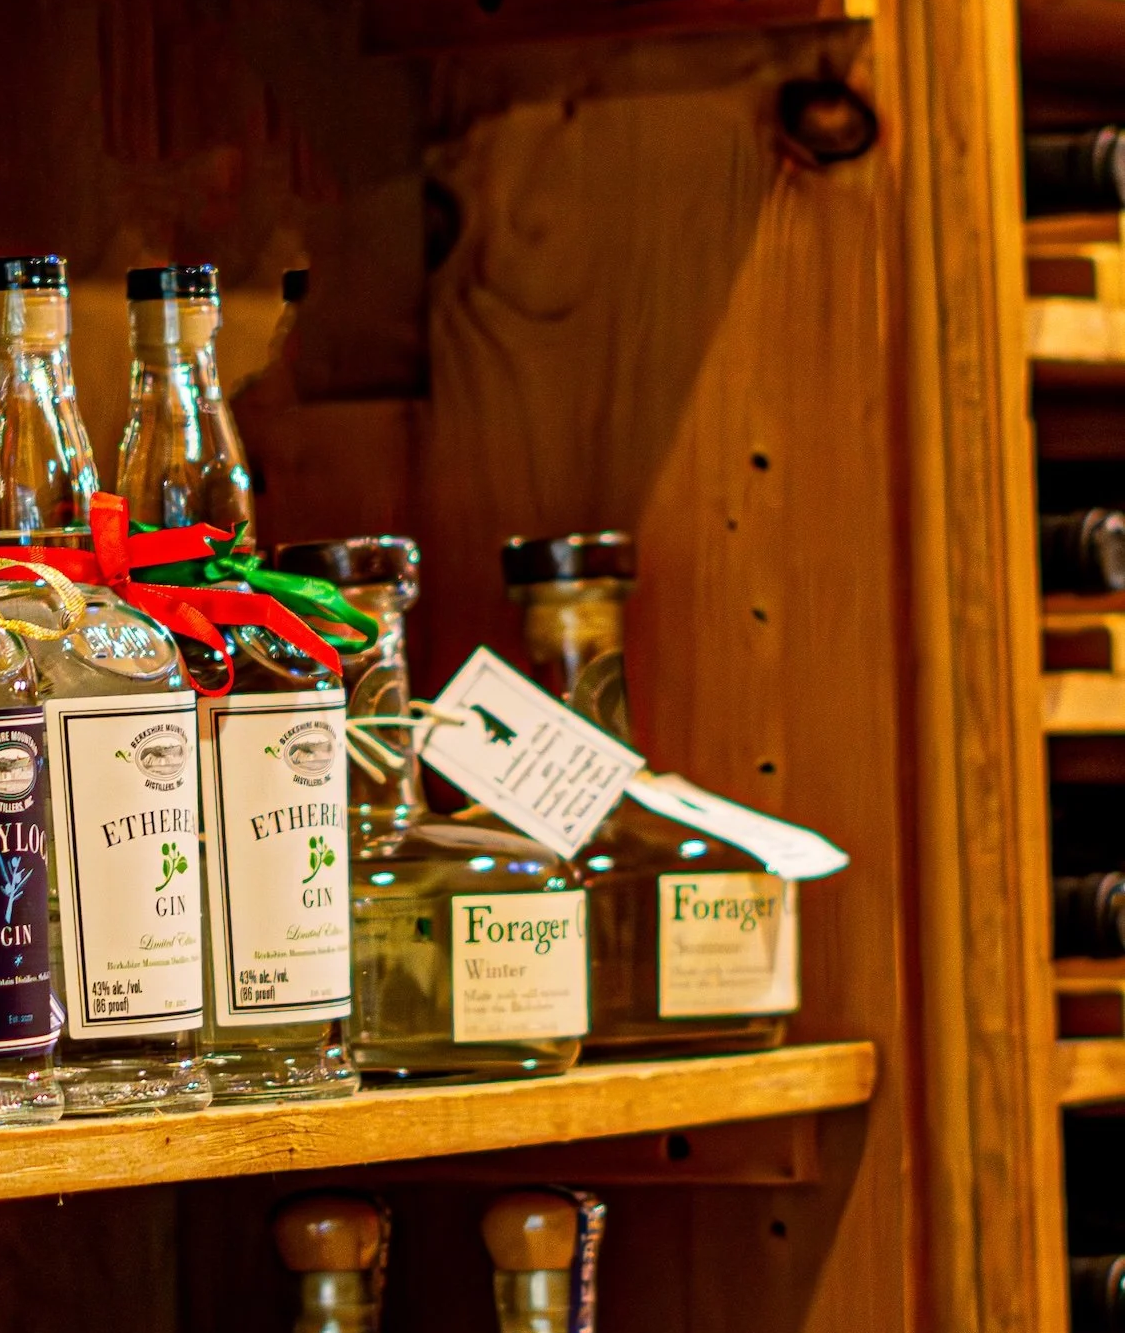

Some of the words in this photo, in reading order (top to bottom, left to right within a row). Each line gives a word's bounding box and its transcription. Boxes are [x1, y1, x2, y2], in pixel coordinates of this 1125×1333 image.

[130, 724, 164, 749] BERKSHIRE
[155, 894, 186, 917] GIN
[302, 887, 332, 908] GIN
[670, 883, 777, 932] Forager
[0, 924, 32, 947] GIN
[462, 904, 570, 955] Forager
[138, 933, 176, 951] Limited
[239, 969, 257, 985] 43%
[464, 957, 527, 981] Winter
[92, 980, 110, 996] 43%
[112, 980, 125, 995] alc.
[239, 986, 253, 1004] (86
[255, 985, 276, 1003] proof)
[93, 998, 106, 1015] (86
[108, 996, 130, 1015] proof)
